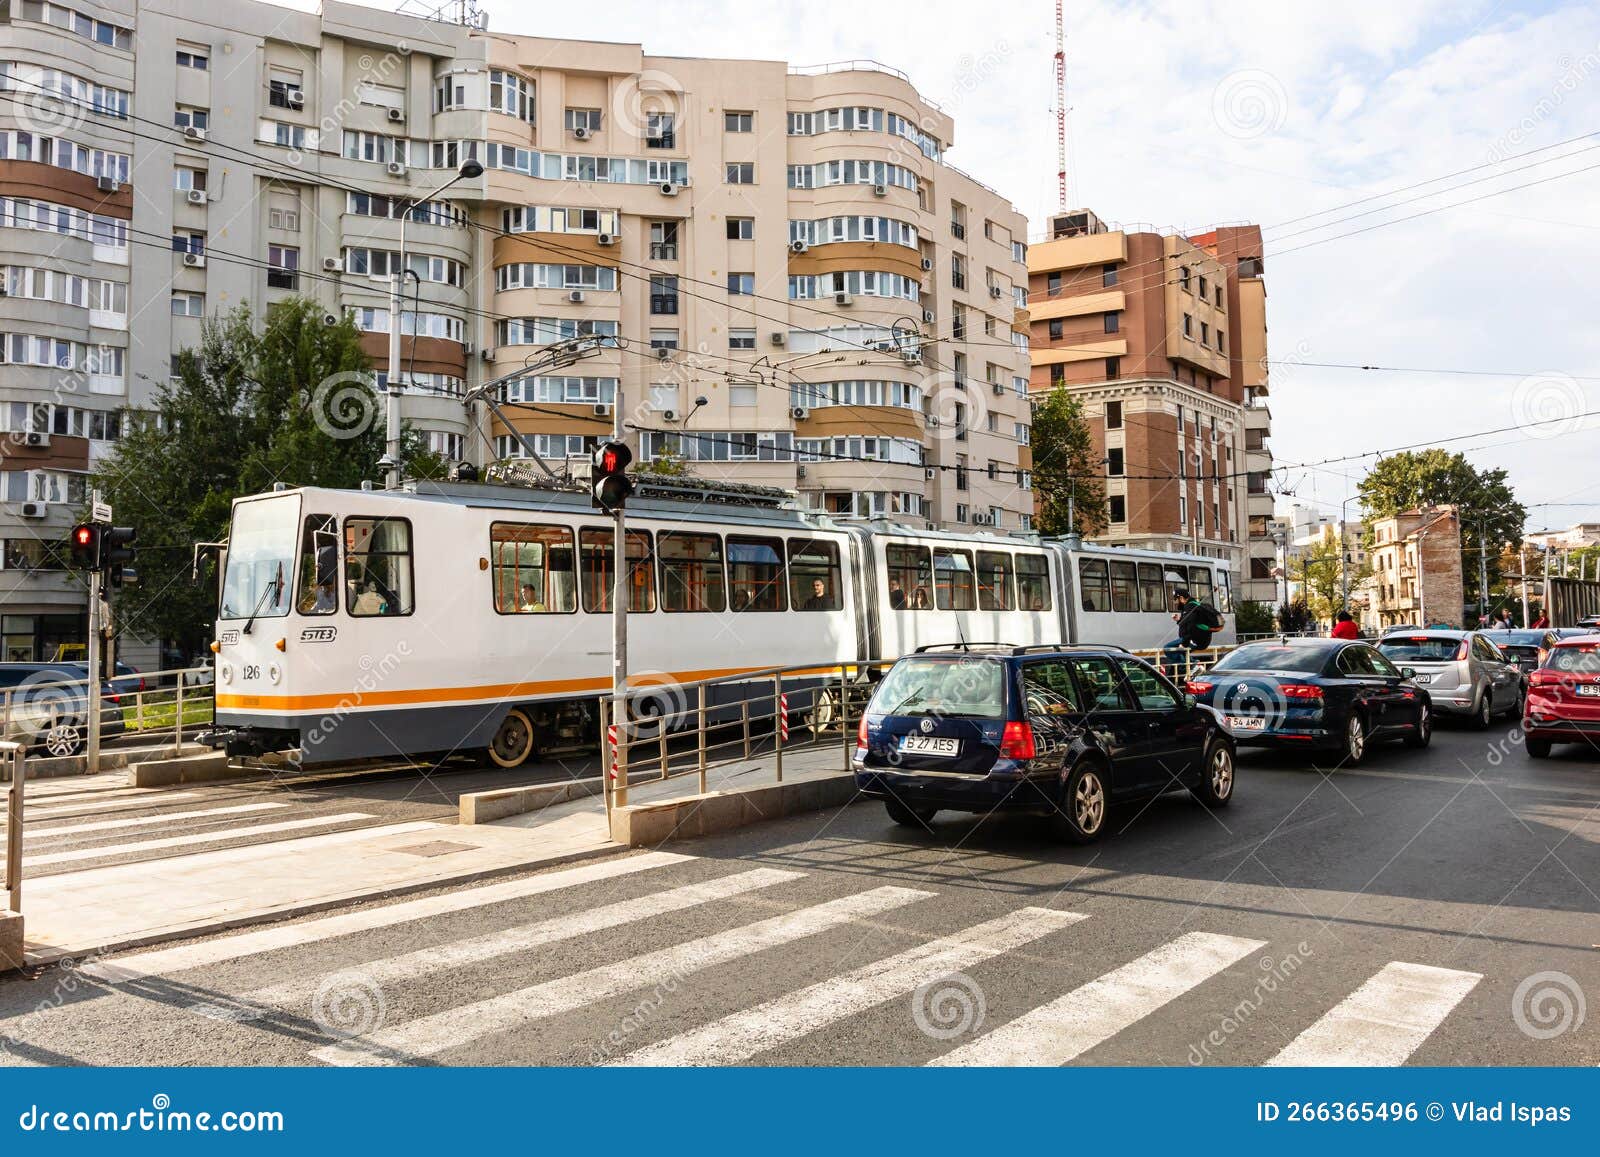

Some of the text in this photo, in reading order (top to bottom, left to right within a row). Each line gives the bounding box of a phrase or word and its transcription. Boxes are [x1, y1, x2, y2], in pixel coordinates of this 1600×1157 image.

[243, 665, 260, 680] 126
[1584, 685, 1590, 693] B
[907, 738, 954, 752] B 27 AES
